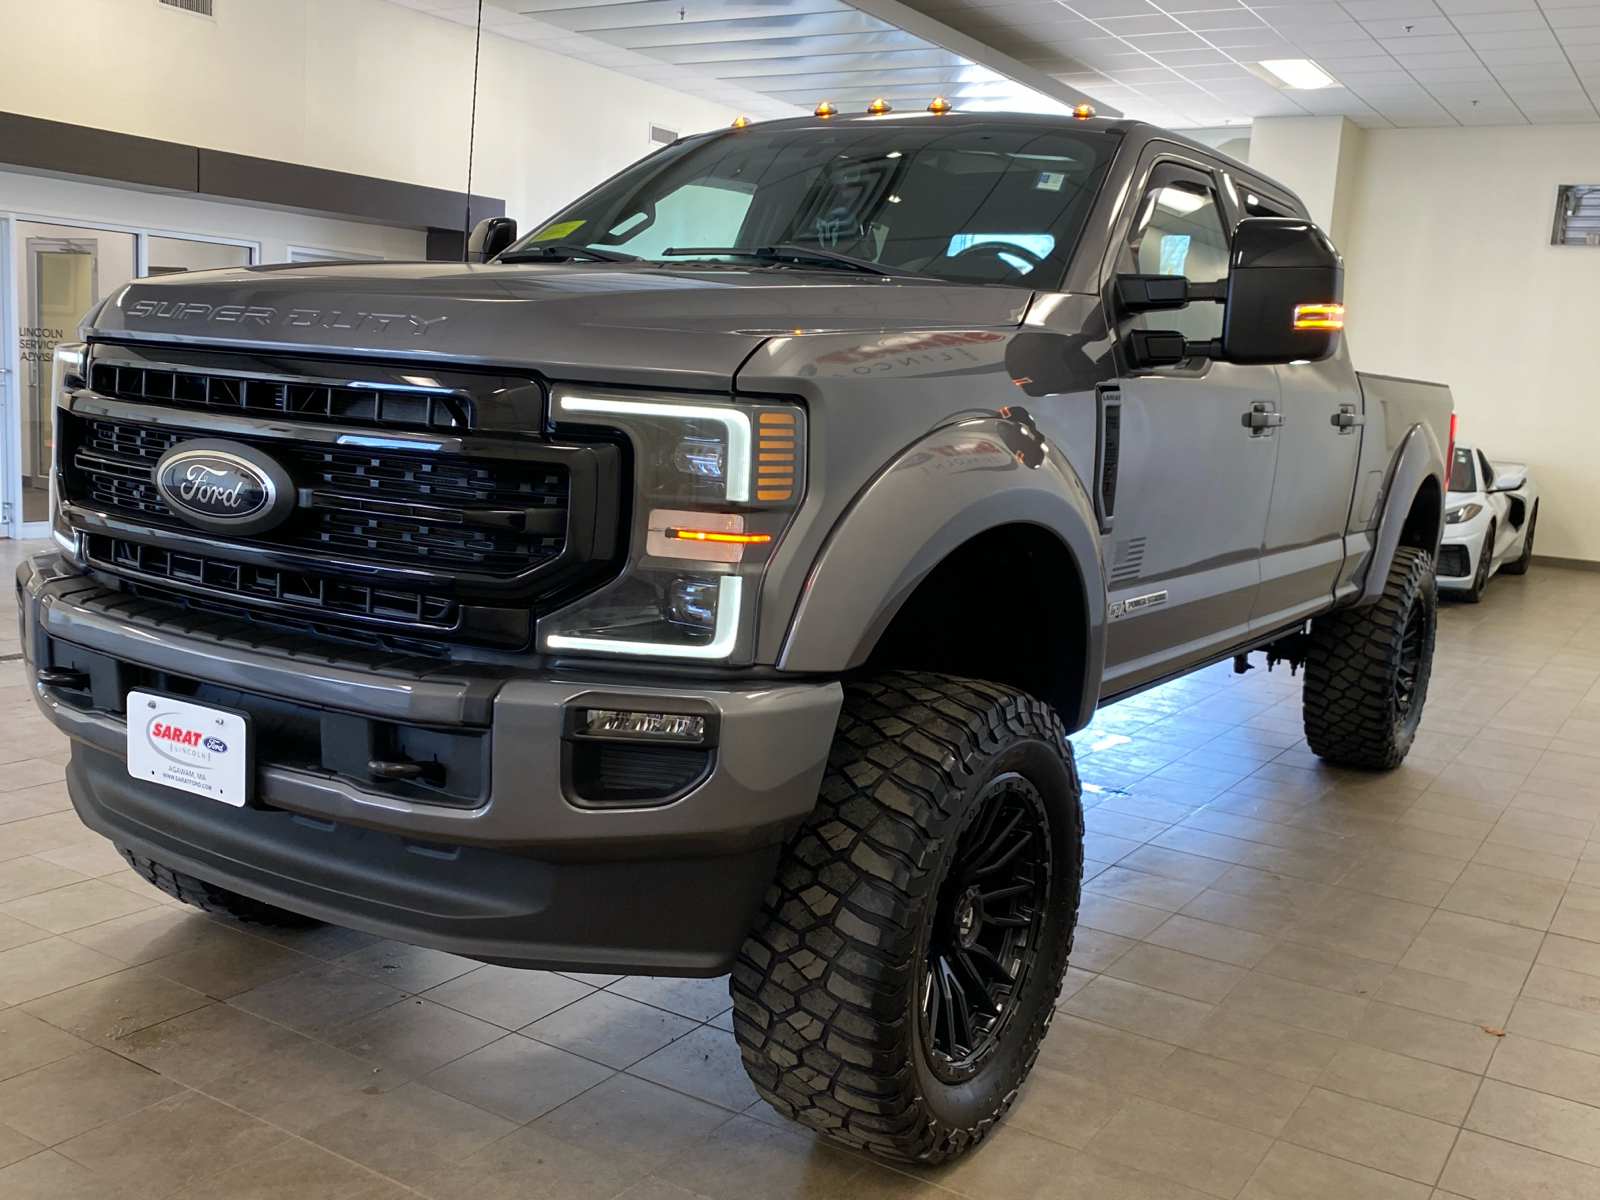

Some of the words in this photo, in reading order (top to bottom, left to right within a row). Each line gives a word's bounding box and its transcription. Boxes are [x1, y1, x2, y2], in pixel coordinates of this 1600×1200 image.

[127, 300, 278, 325] SUPER
[285, 309, 448, 335] DUTY
[19, 327, 63, 338] LINCOLN
[20, 352, 54, 362] ADVIS
[180, 464, 243, 508] Ford
[151, 721, 202, 747] SARAT
[206, 738, 224, 753] Ford
[174, 746, 206, 759] LINCOLN
[162, 772, 212, 790] WWW.SARATFORD.COM
[168, 765, 196, 778] AGAWAM,
[197, 773, 207, 781] MA
